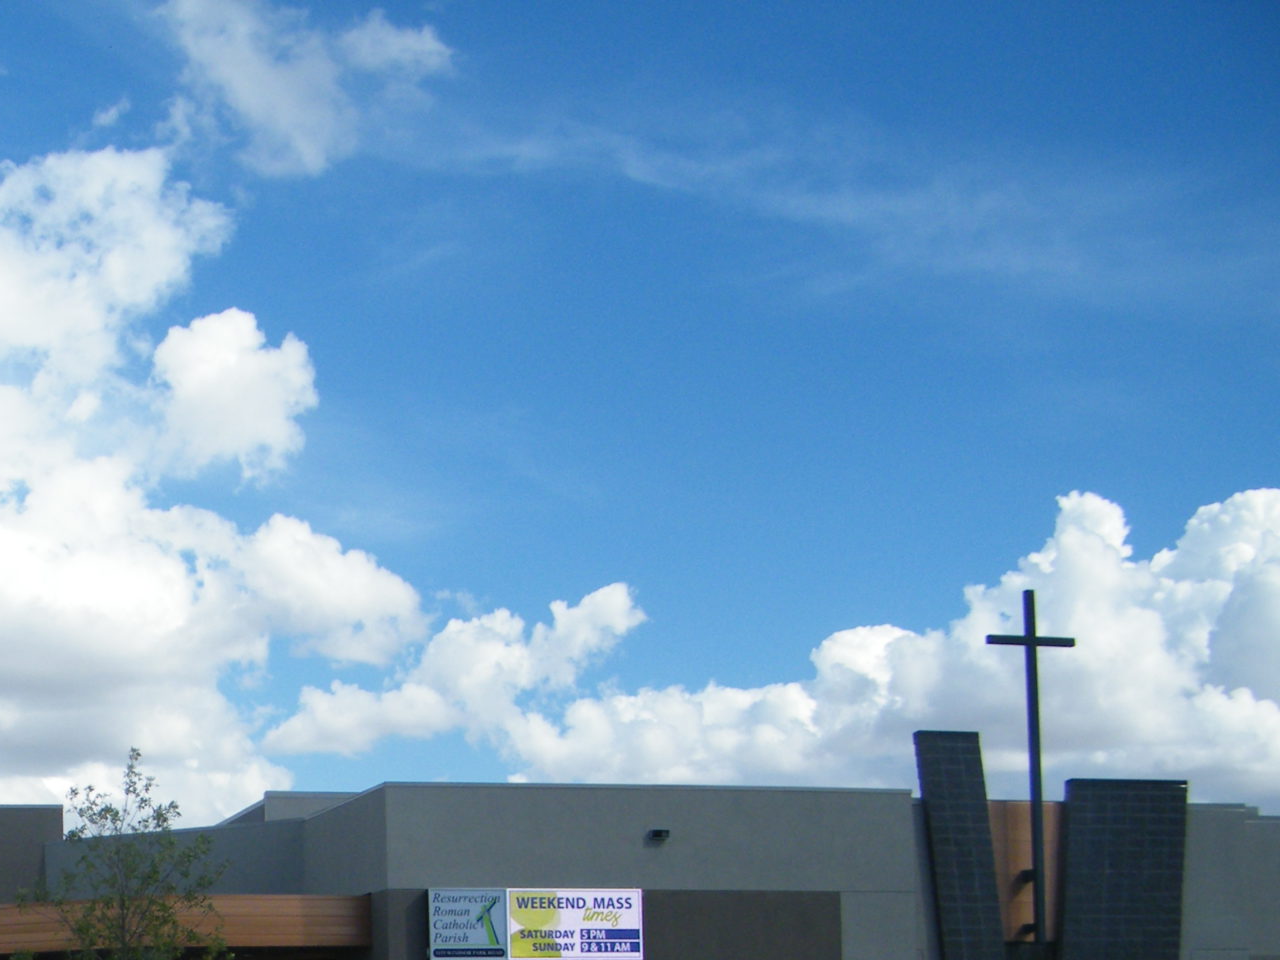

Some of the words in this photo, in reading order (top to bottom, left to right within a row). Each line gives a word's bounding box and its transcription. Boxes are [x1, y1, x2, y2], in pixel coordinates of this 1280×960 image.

[433, 892, 501, 904] Resurrection
[516, 897, 586, 909] WEEKEND
[593, 897, 633, 909] MASS
[433, 906, 471, 917] Roman
[582, 907, 622, 928] times
[433, 919, 479, 931] Catholic
[434, 933, 469, 943] Parish
[520, 929, 575, 939] SATURDAY
[581, 930, 588, 939] 5
[589, 930, 606, 939] PM
[532, 942, 576, 952] SUNDAY
[581, 943, 589, 952] 9
[590, 943, 598, 952] &
[600, 943, 611, 952] 11
[614, 943, 631, 952] AM
